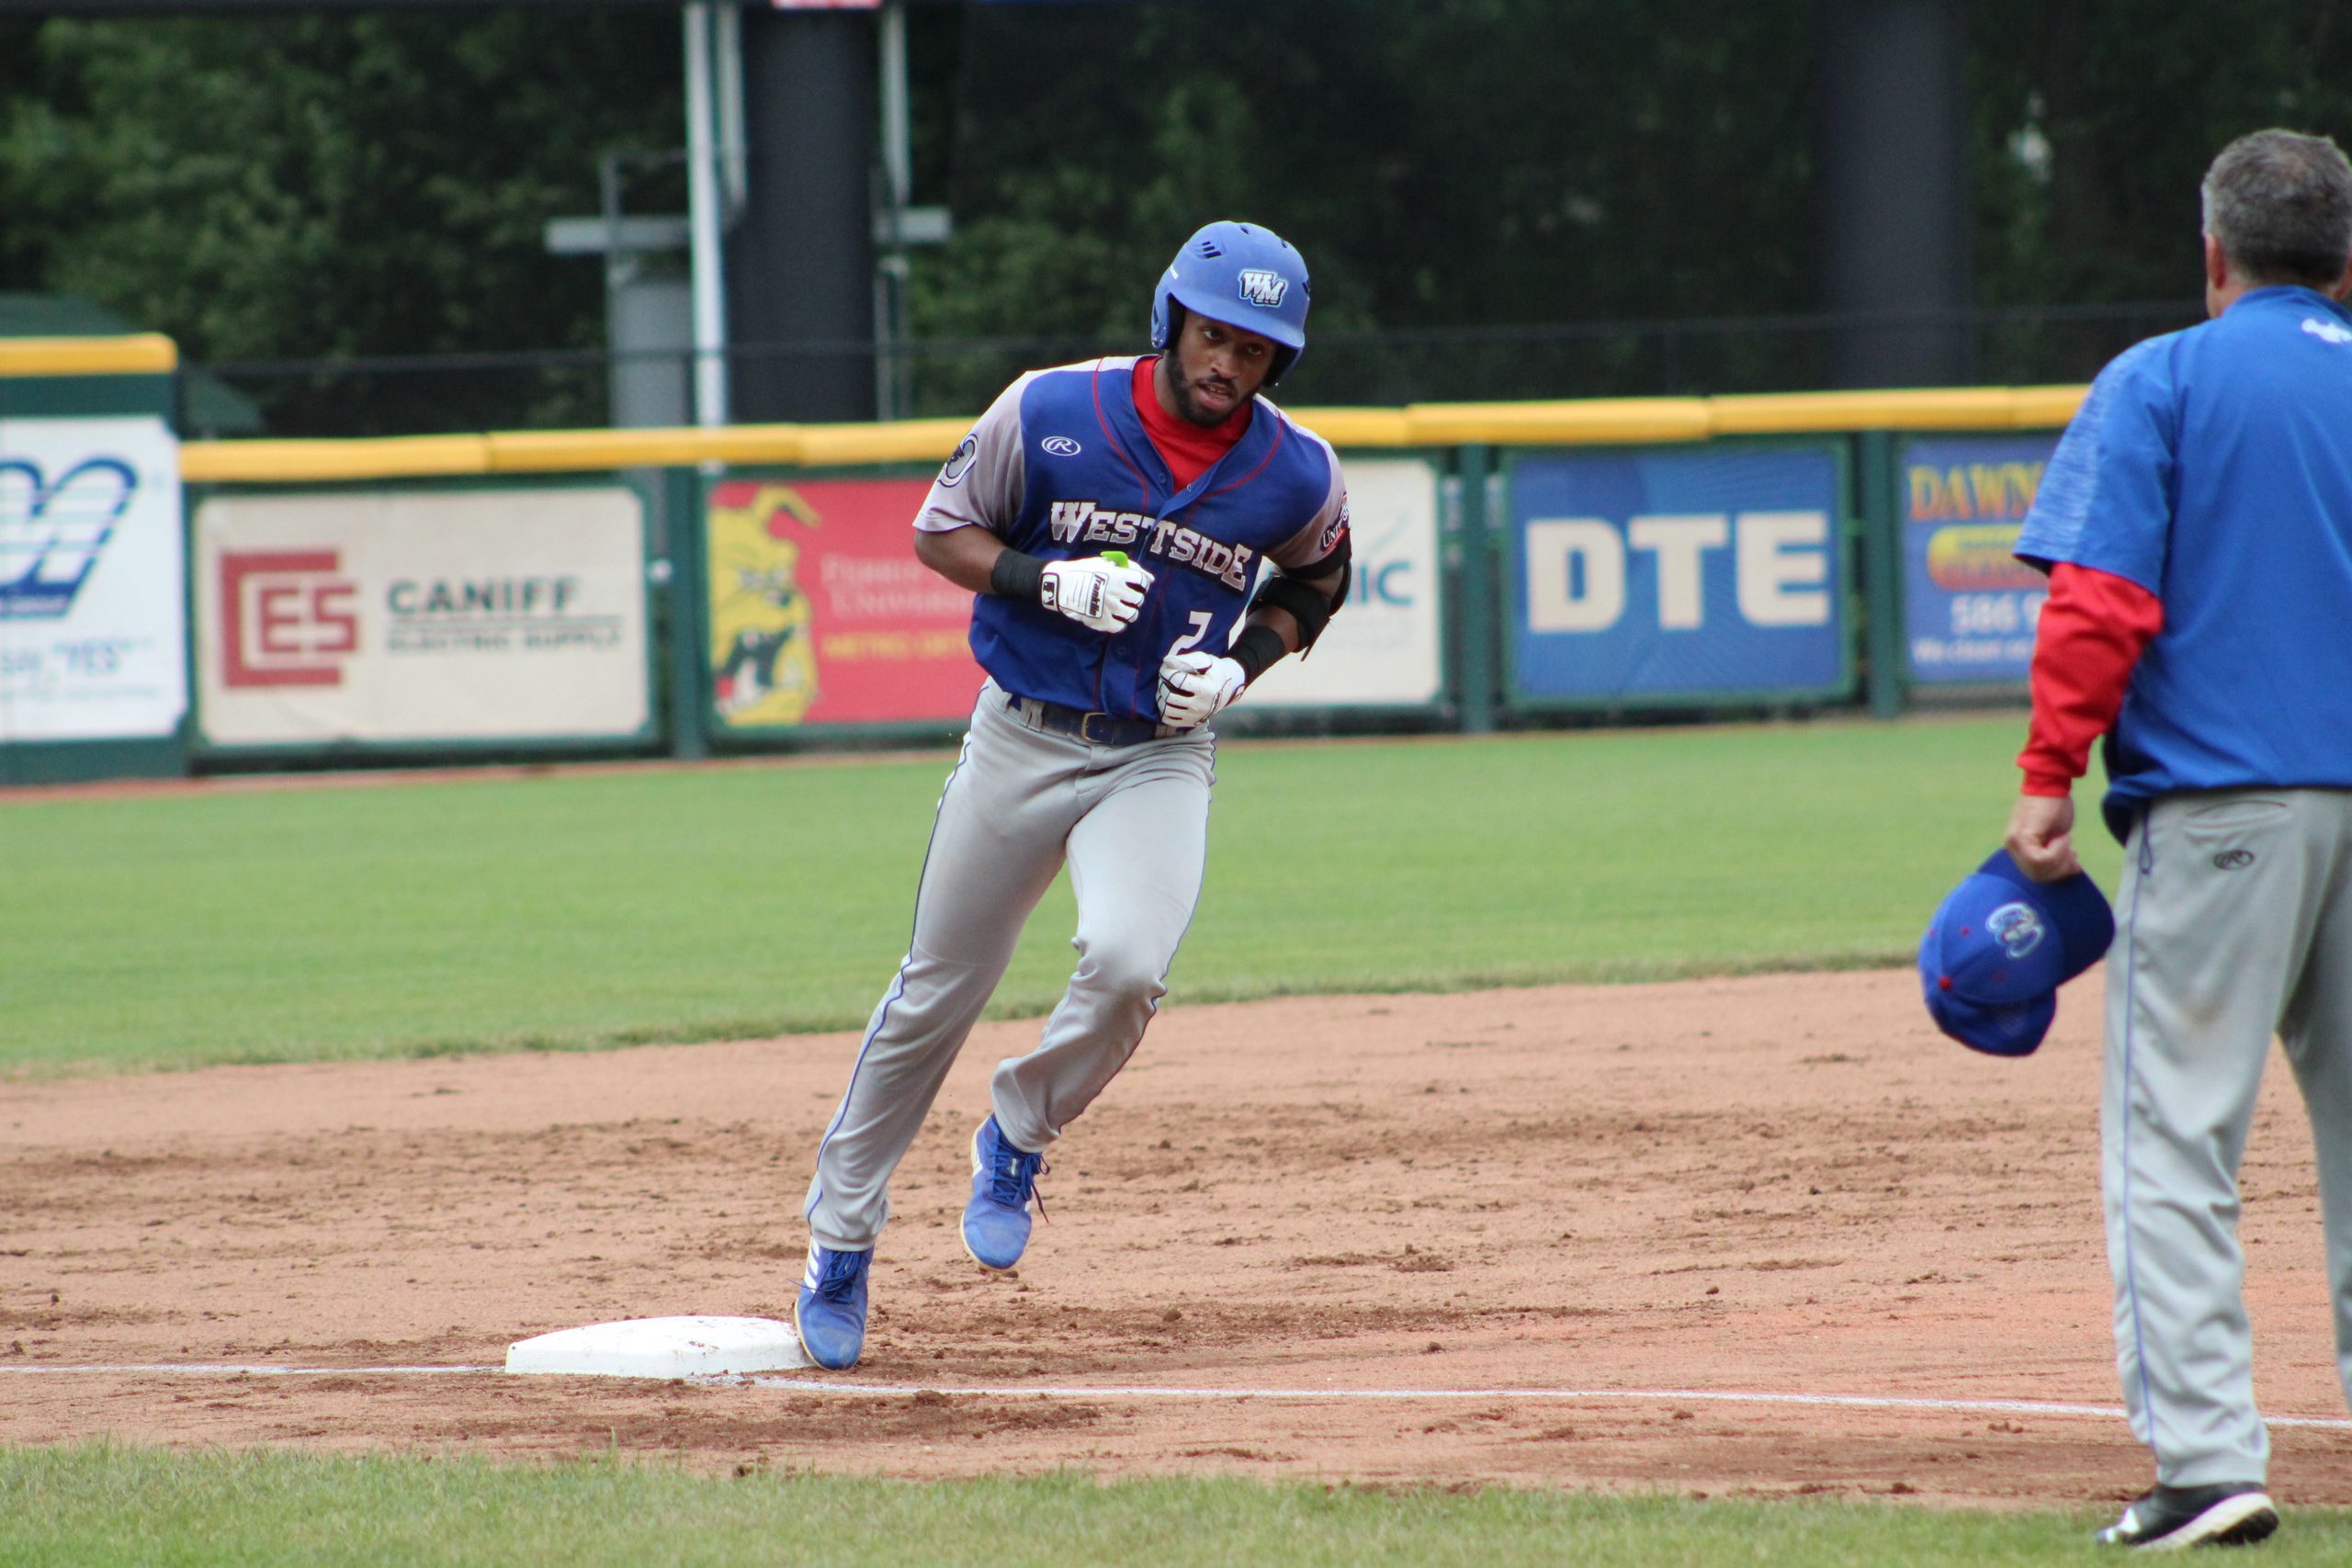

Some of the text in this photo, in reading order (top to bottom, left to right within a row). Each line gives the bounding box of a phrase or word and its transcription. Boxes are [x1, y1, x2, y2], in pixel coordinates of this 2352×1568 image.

[1240, 269, 1286, 306] WM
[1050, 501, 1253, 592] WESTSIDE
[386, 578, 579, 615] CANIFF
[1344, 560, 1414, 608] IC
[1525, 511, 1830, 634] DTE
